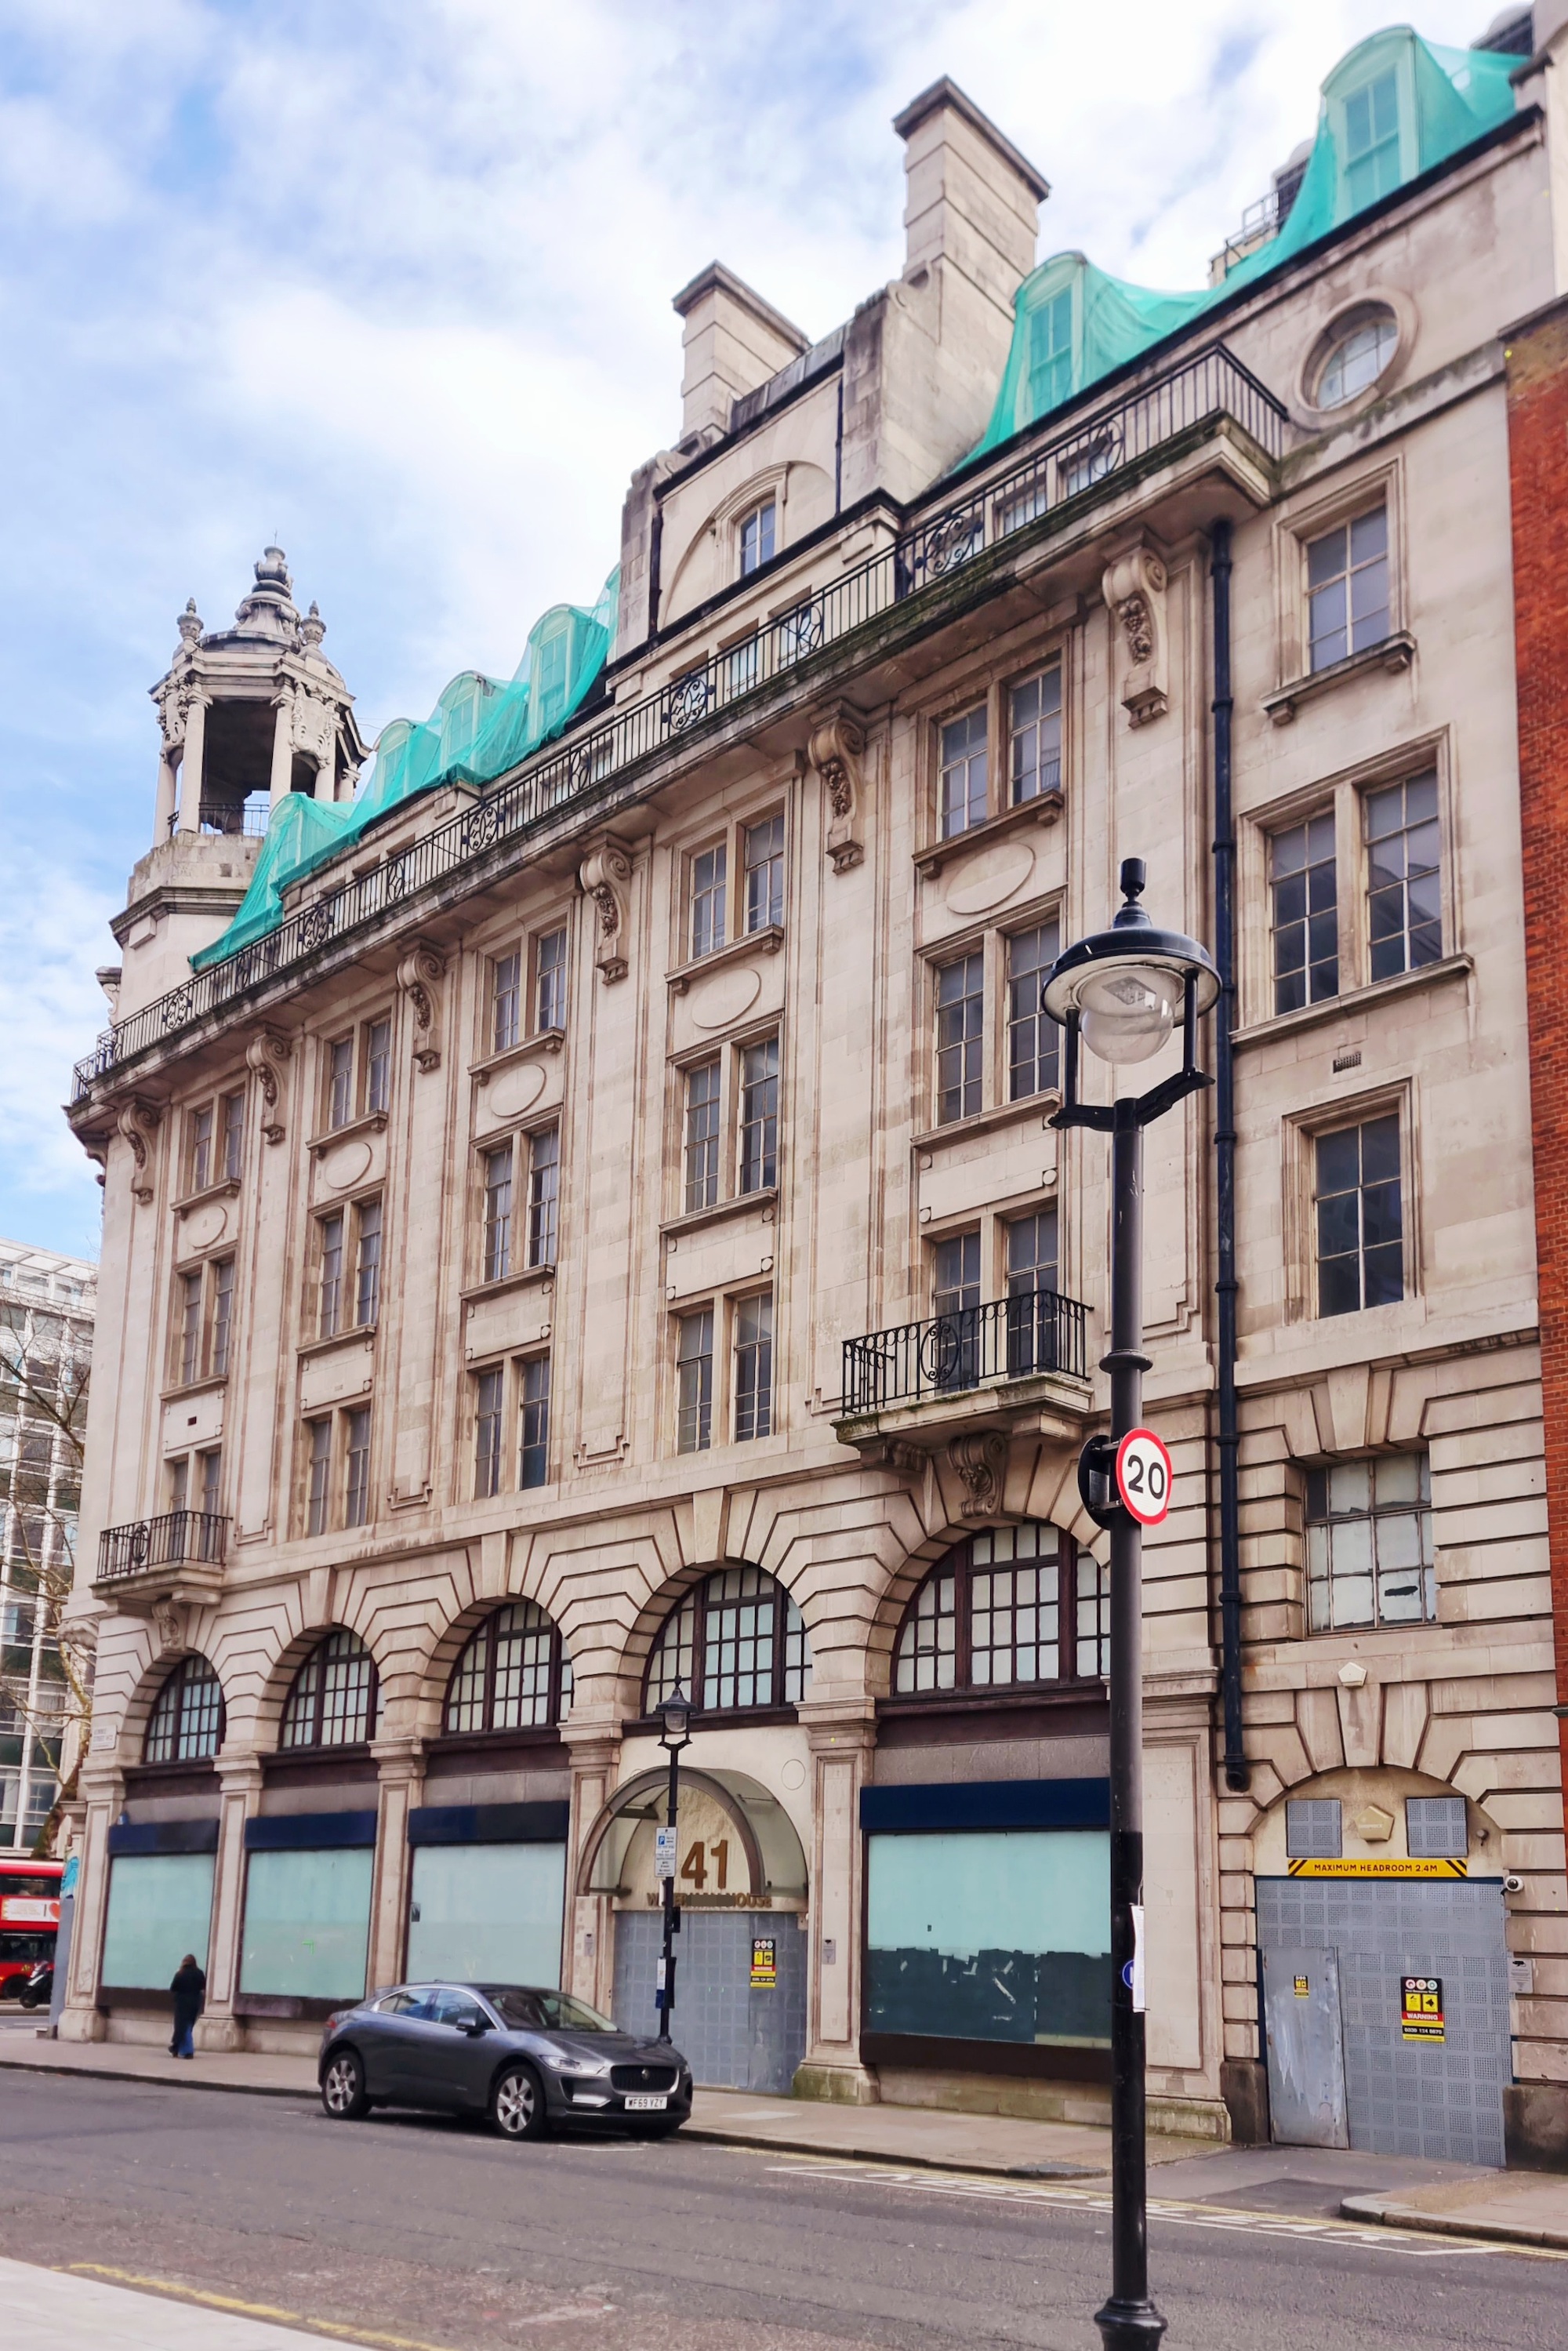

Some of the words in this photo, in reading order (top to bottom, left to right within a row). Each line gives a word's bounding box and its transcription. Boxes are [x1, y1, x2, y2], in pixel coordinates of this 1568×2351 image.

[1127, 1454, 1165, 1500] 20
[681, 1839, 728, 1890] 41
[1406, 2012, 1439, 2021] WARNING
[628, 2098, 648, 2108] WF69
[866, 2173, 1090, 2200] KEEP
